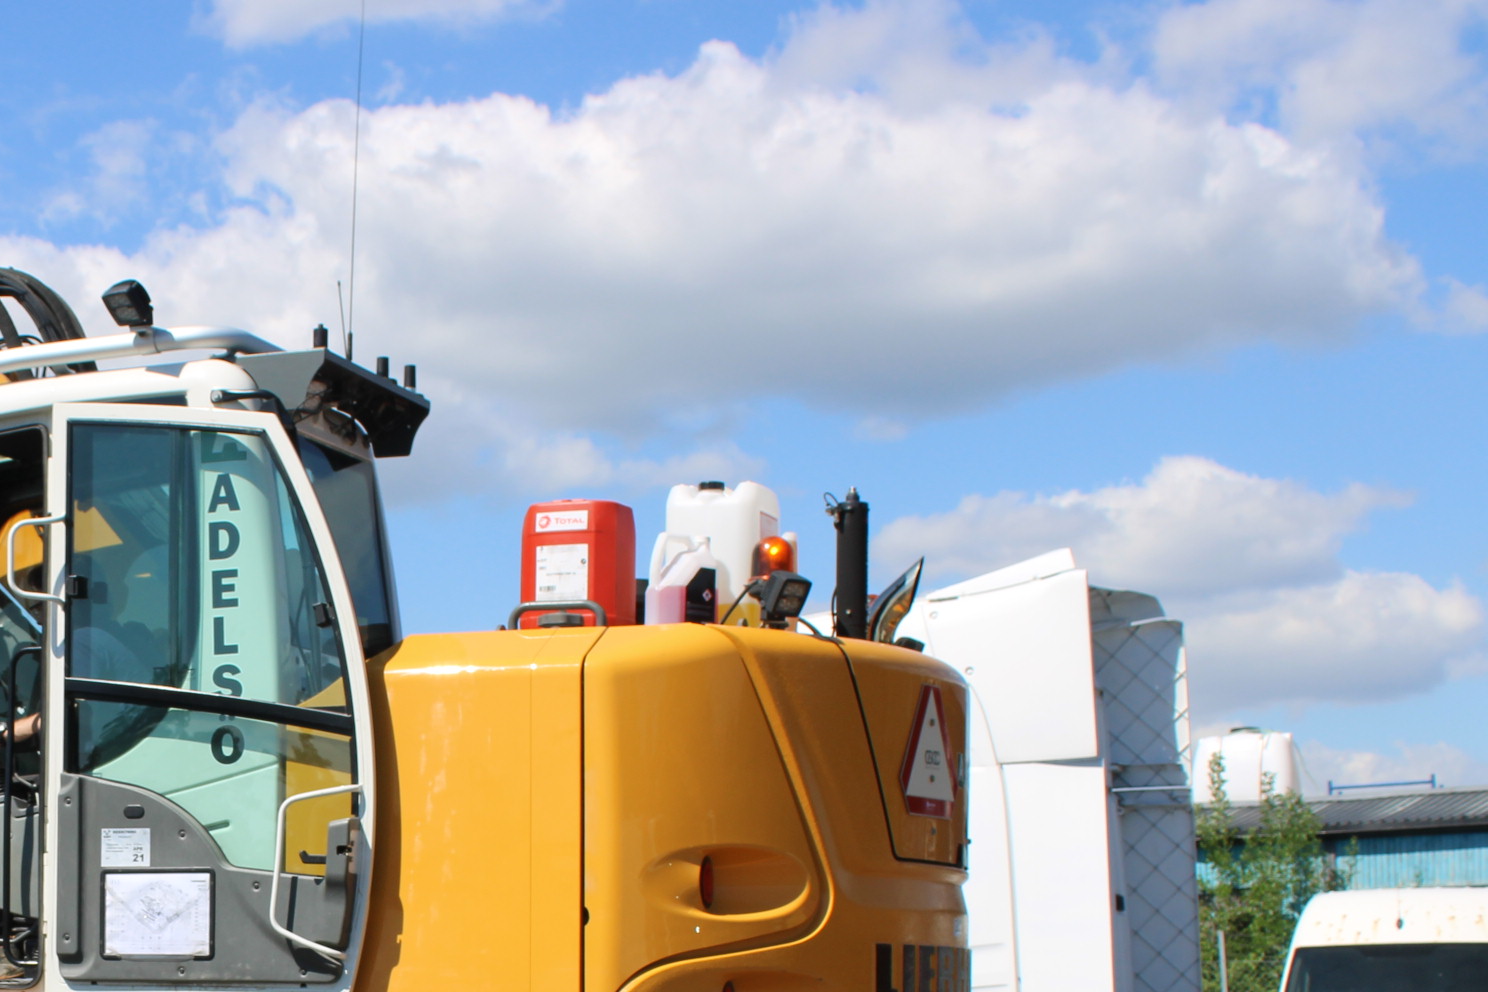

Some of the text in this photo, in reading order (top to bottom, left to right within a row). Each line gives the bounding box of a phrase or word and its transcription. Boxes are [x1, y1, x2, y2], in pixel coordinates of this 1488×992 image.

[554, 517, 584, 525] TOTAL
[208, 473, 245, 764] ADELSÖ
[132, 853, 144, 862] 21
